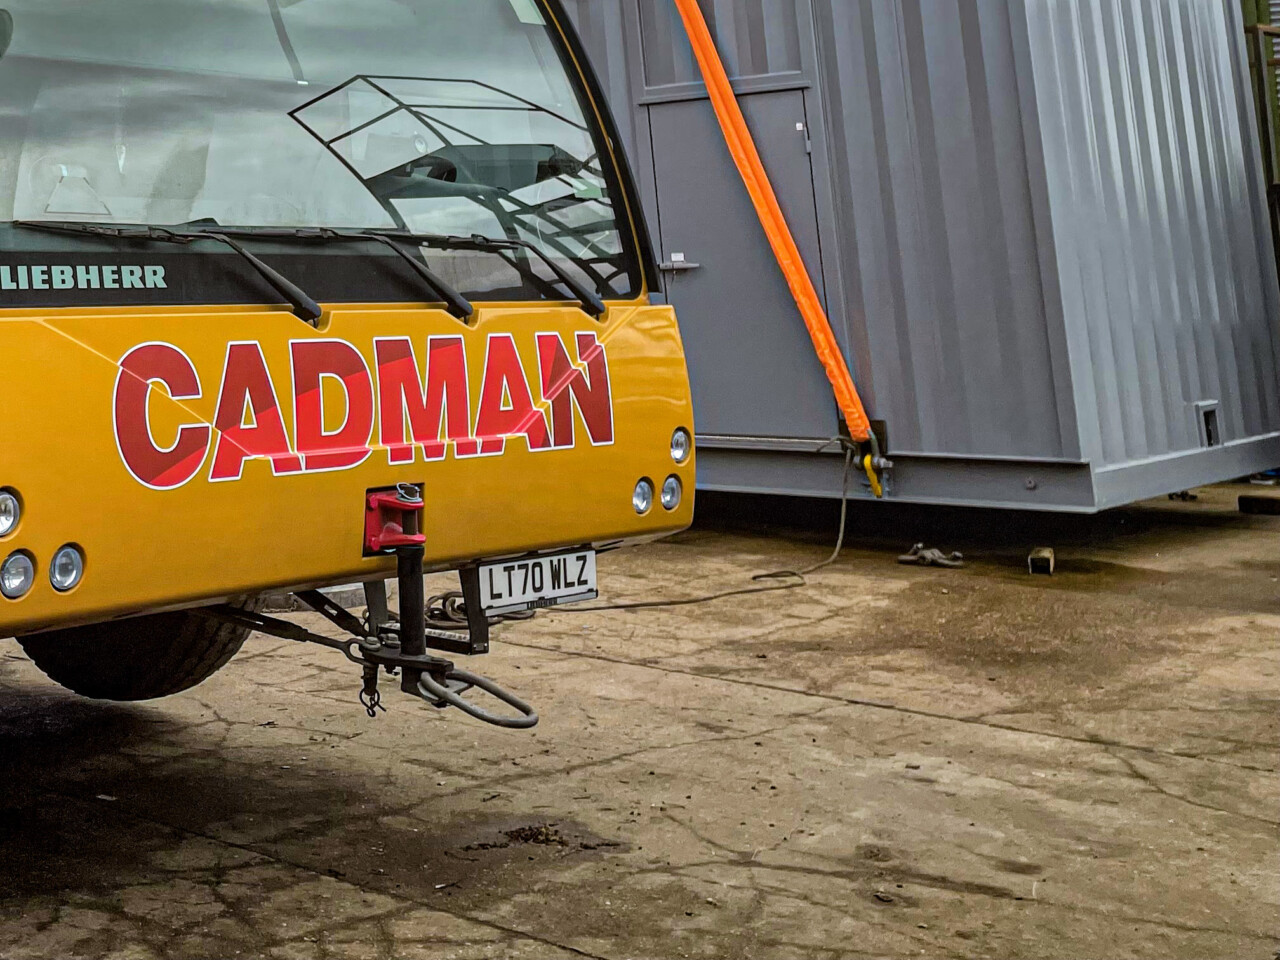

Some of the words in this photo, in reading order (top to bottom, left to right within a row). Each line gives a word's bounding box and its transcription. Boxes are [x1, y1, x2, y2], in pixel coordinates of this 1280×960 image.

[0, 265, 168, 290] LIEBHERR
[112, 331, 615, 491] CADMAN
[488, 561, 544, 600] LT70
[549, 555, 589, 590] WLZ
